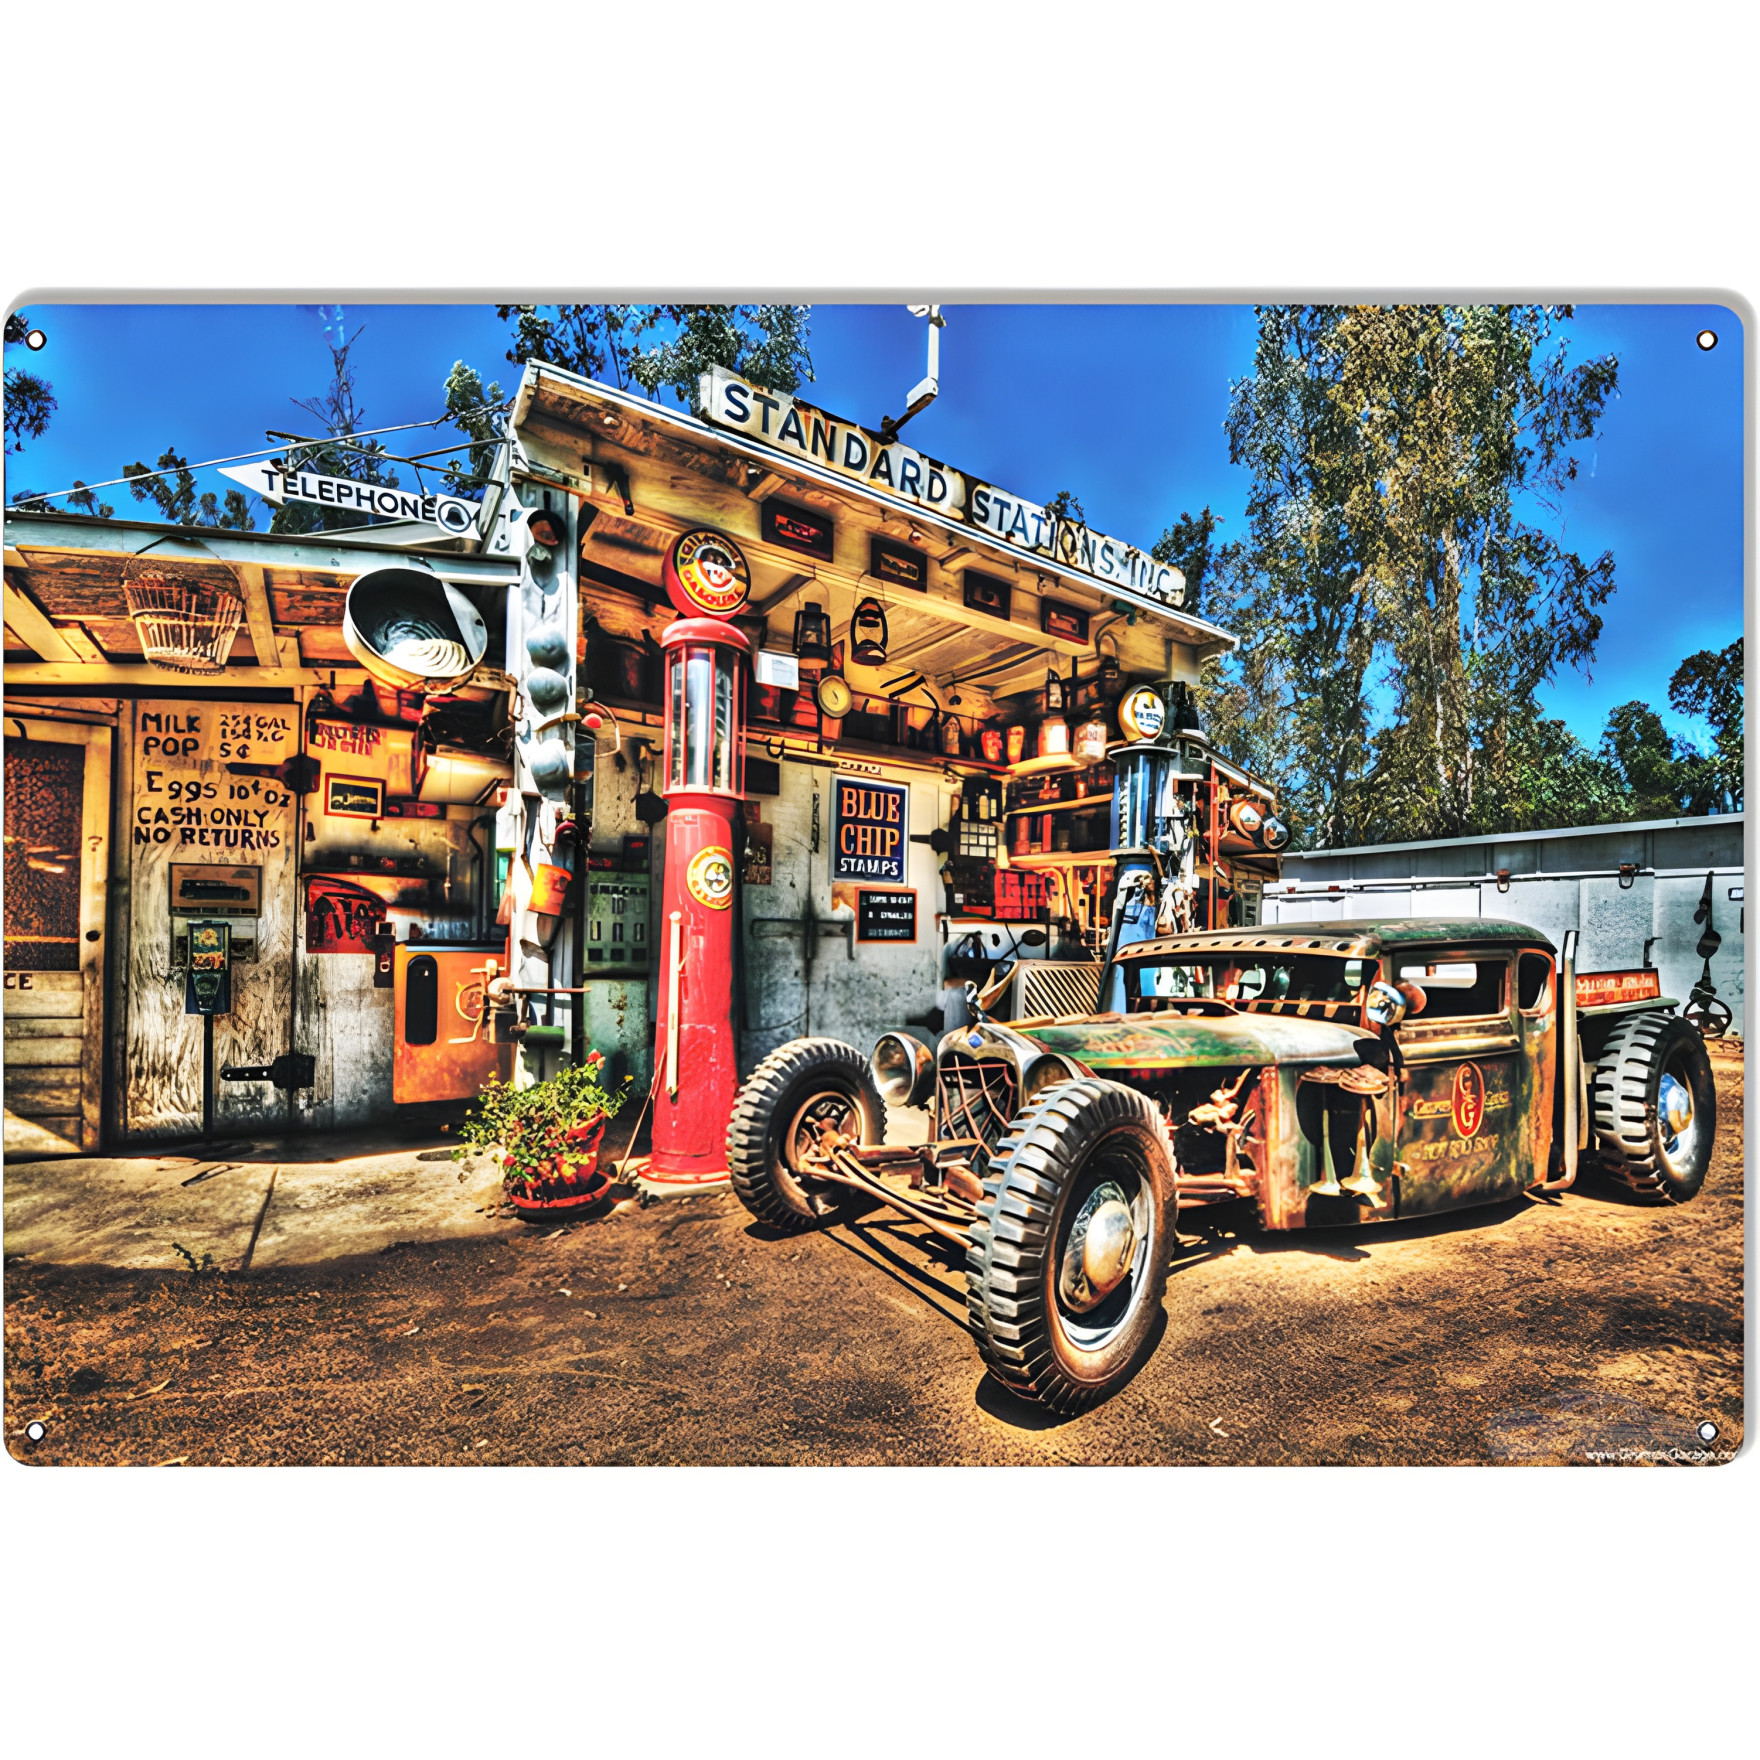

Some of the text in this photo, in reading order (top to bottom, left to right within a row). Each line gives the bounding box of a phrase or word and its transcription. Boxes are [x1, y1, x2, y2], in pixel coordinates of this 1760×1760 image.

[724, 383, 947, 503] STANDARD
[261, 469, 437, 522] TELEPHONE
[141, 713, 200, 734] MILK
[143, 736, 200, 757] POP
[146, 771, 218, 803] Eggs
[137, 807, 270, 828] CASH ONLY
[841, 787, 900, 823] BLUE
[134, 826, 280, 850] NO RETURNS
[840, 823, 900, 857] CHIP
[840, 857, 899, 876] STAMPS
